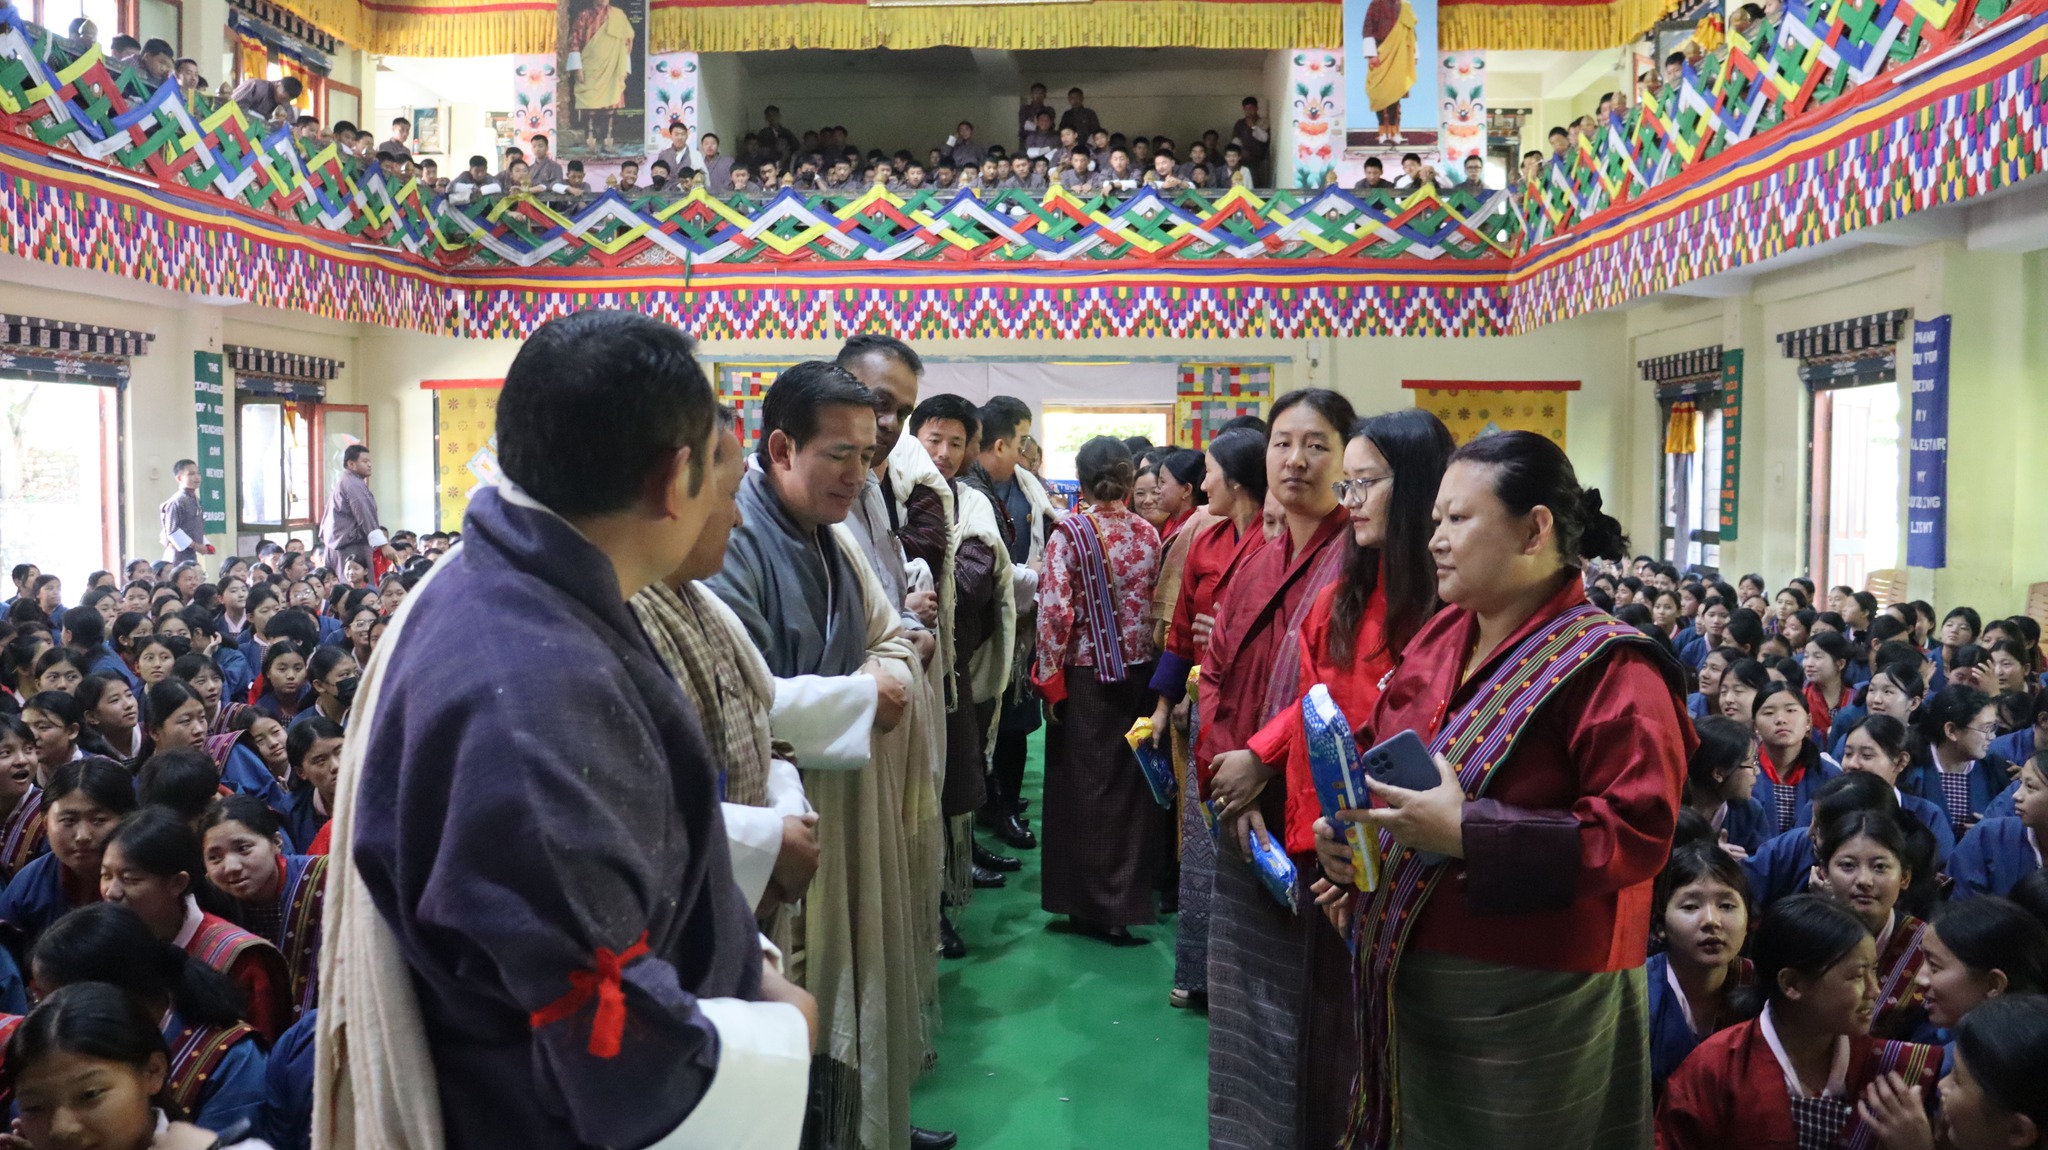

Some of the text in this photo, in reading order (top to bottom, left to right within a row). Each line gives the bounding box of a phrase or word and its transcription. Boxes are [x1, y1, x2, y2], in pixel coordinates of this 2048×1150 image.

[1914, 330, 1936, 344] THANK
[1912, 350, 1938, 366] OU FOR
[195, 381, 223, 394] INFLUENC
[195, 402, 206, 412] OF
[1915, 408, 1927, 422] MY
[209, 446, 220, 456] CAN
[206, 468, 224, 478] NEVER
[1916, 470, 1926, 483] MY
[1908, 495, 1941, 509] UIDING
[1910, 521, 1934, 534] LIGHT
